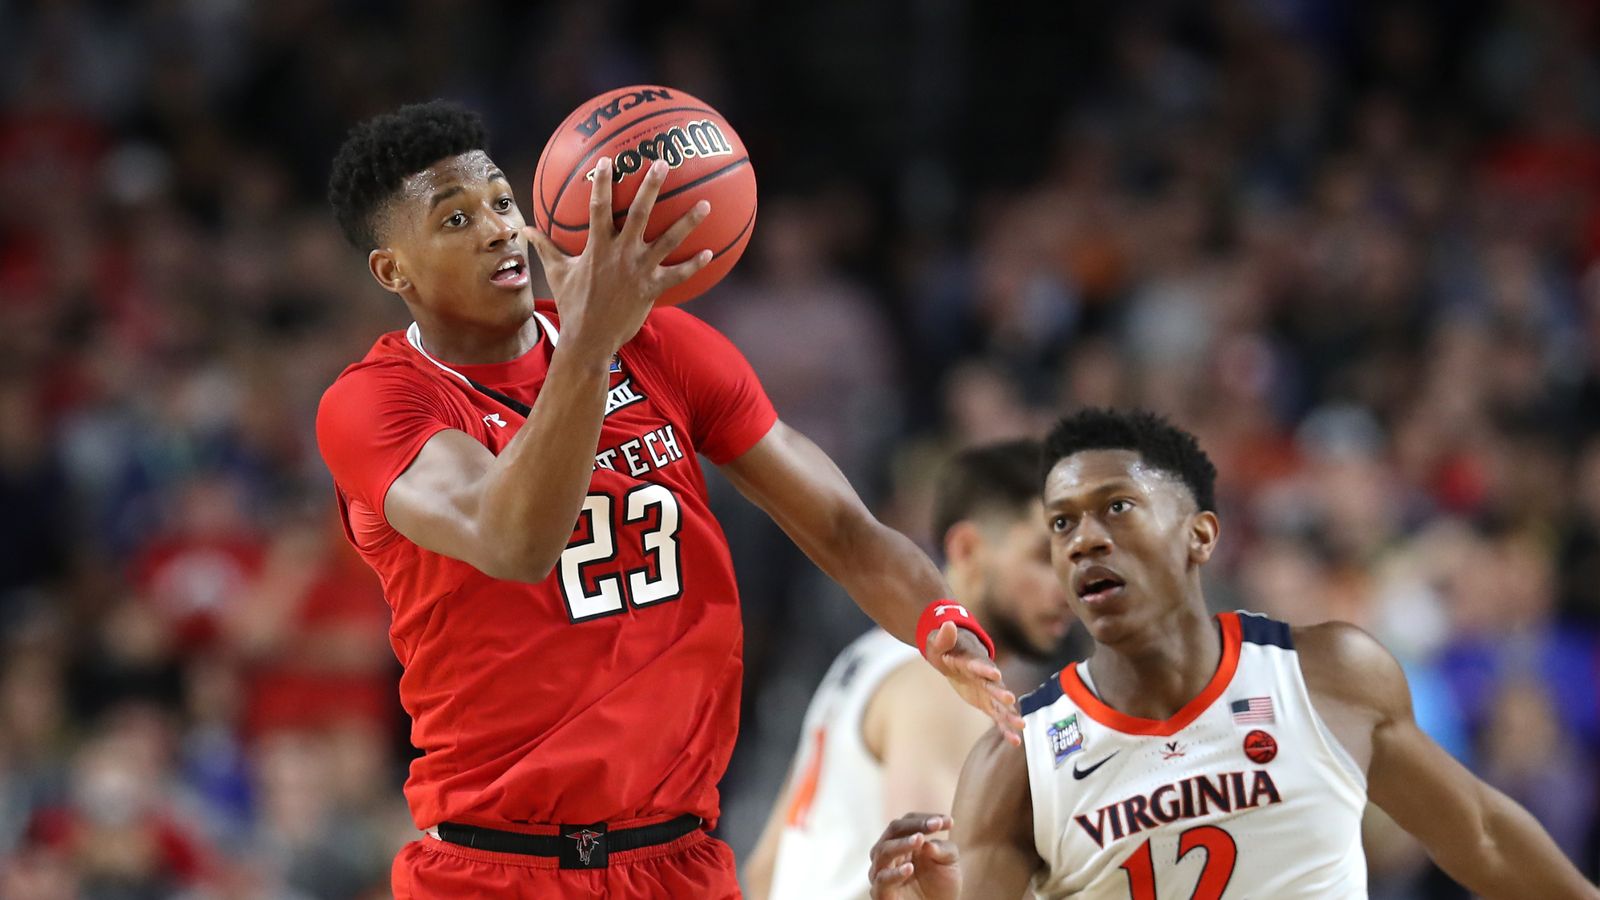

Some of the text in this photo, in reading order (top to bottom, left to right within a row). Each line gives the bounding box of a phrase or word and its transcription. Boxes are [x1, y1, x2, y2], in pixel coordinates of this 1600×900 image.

[575, 88, 673, 138] NCAA
[585, 119, 733, 183] Wilso
[595, 424, 683, 477] TECH
[557, 482, 684, 624] 23
[1074, 770, 1282, 849] VIRGINIA
[1119, 824, 1238, 900] 12
